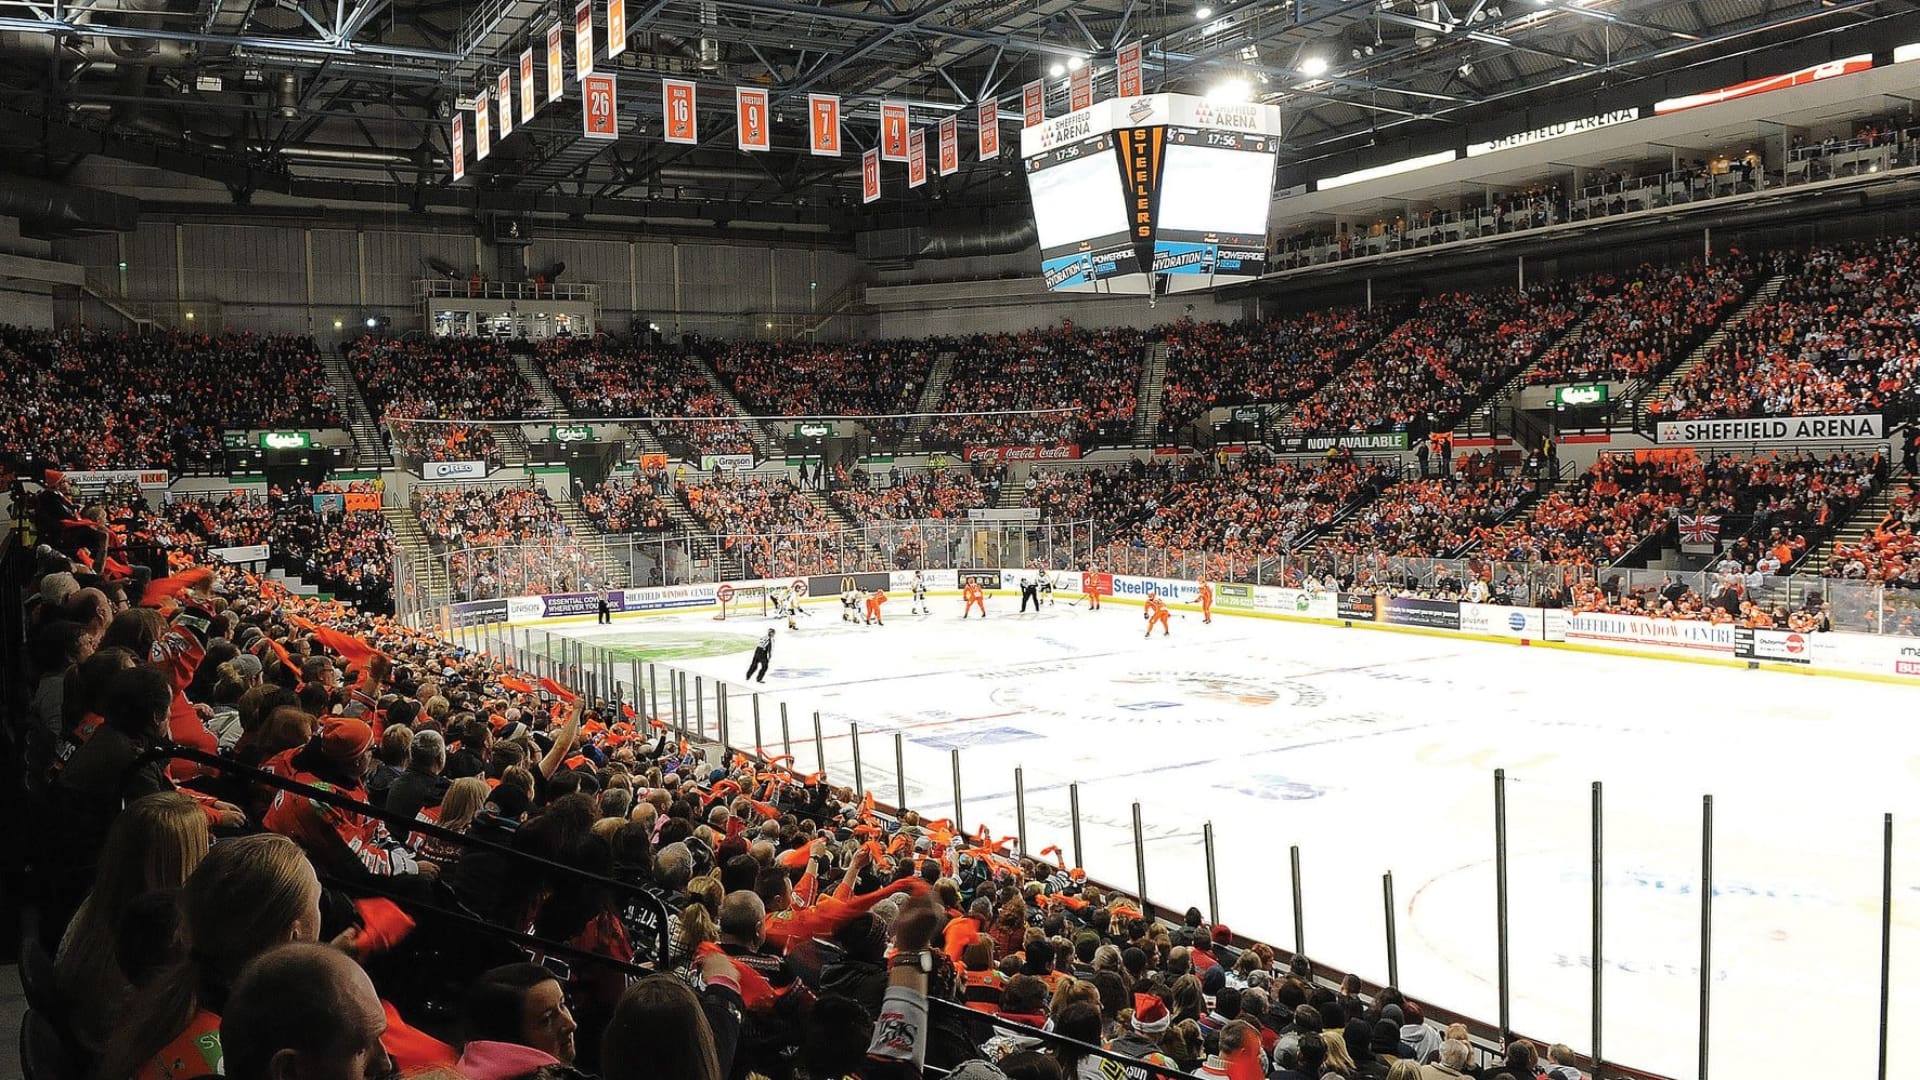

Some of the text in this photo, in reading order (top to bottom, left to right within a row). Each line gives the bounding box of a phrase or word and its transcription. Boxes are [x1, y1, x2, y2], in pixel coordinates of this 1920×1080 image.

[591, 91, 610, 116] 26
[672, 99, 688, 121] 16
[748, 105, 758, 128] 9
[821, 112, 830, 134] 7
[1056, 111, 1091, 130] SHEFFIELD
[1216, 113, 1257, 129] ARENA
[1574, 109, 1632, 131] ARENA
[891, 119, 899, 140] 4
[1056, 122, 1091, 143] ARENA
[1208, 133, 1236, 146] 17:56
[1056, 145, 1079, 160] 17:56
[1134, 129, 1151, 237] STEELERS
[1092, 248, 1136, 263] POWERADE
[1152, 251, 1202, 271] HYDRATION
[1217, 250, 1265, 261] POWERADE
[1046, 262, 1081, 288] HYDRATION
[1685, 418, 1874, 441] SHEFFIELD ARENA
[1307, 438, 1336, 450] NOW
[1338, 435, 1402, 449] AVAILABLE
[437, 464, 472, 477] OREO
[1113, 579, 1180, 598] SteelPhalt
[1567, 617, 1626, 634] SHEFFIELD
[1630, 621, 1679, 637] WINDOW
[1684, 627, 1731, 643] CENTRE
